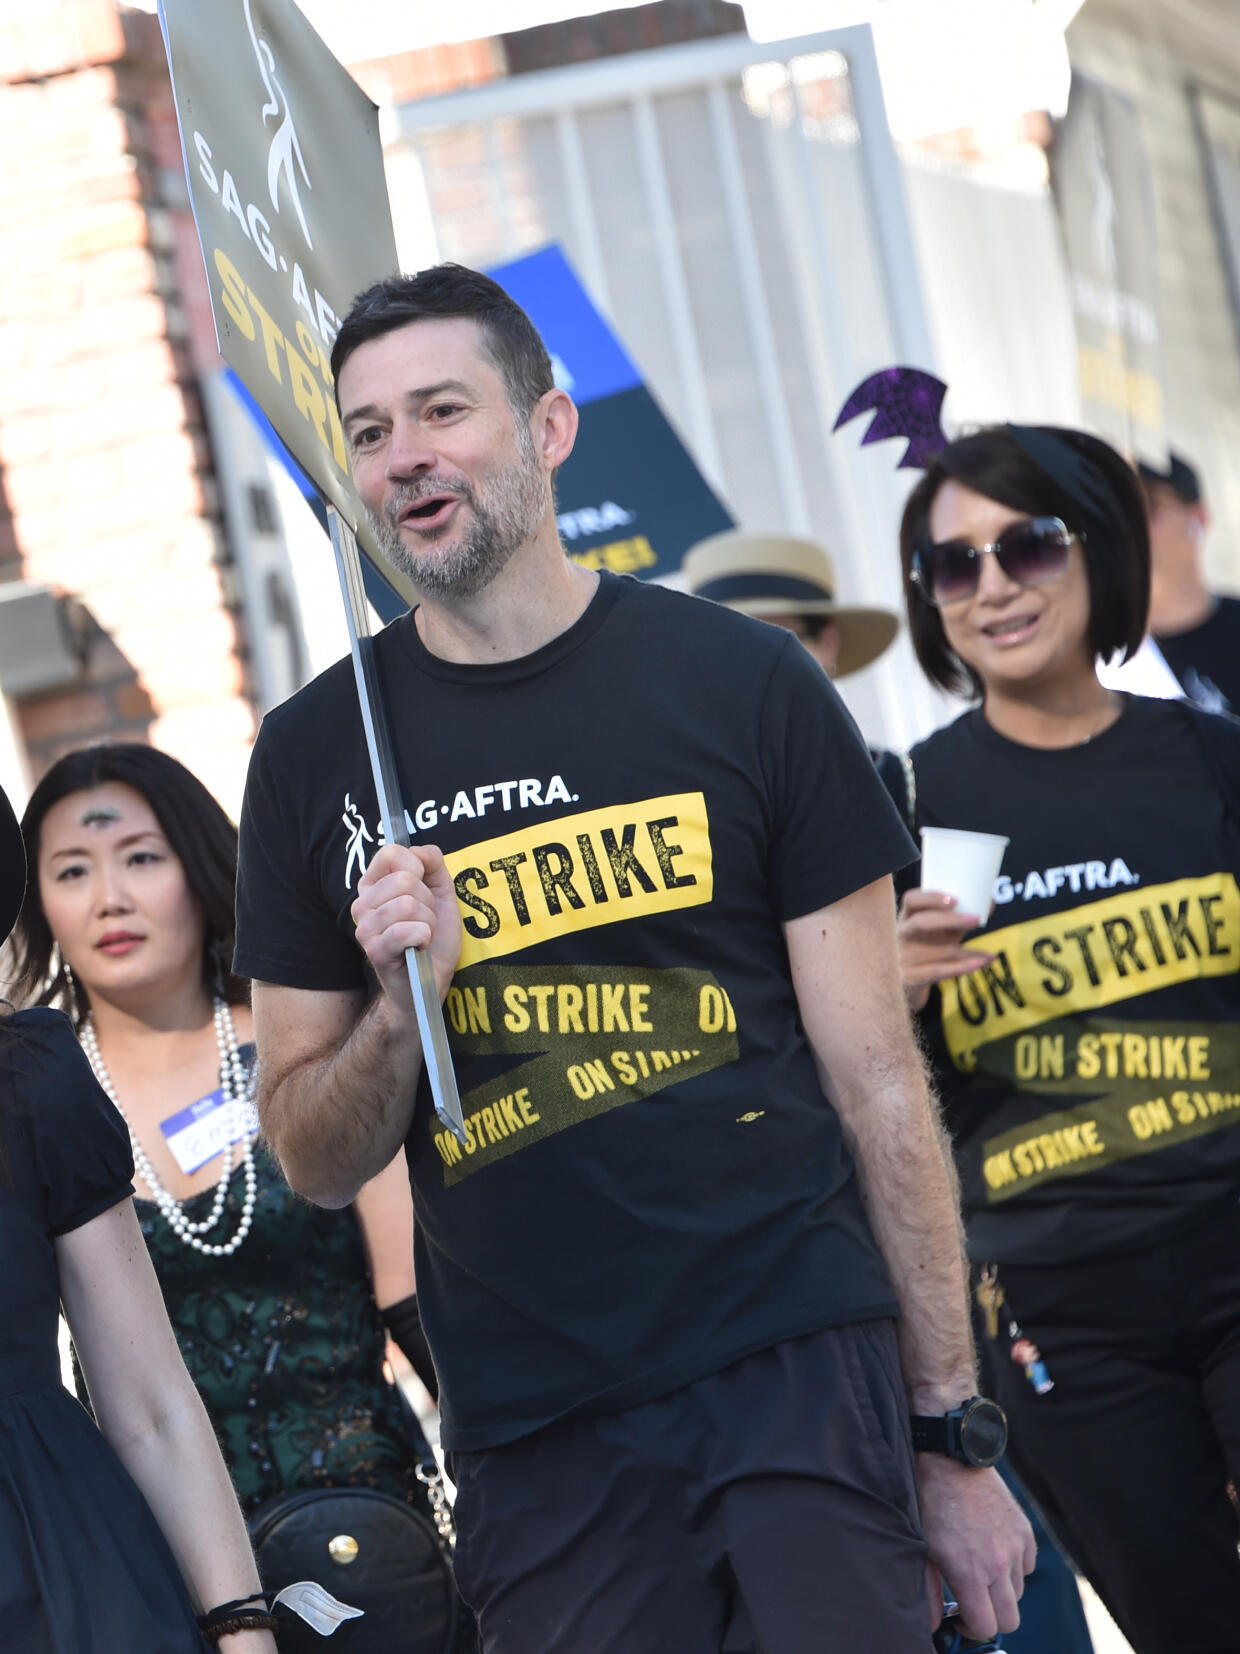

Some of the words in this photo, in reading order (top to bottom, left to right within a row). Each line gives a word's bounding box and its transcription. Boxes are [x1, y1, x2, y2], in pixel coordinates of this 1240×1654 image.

[453, 816, 697, 939] STRIKE
[1031, 894, 1231, 998] STRIKE
[446, 986, 492, 1034] ON
[503, 984, 654, 1034] STRIKE
[1015, 1035, 1064, 1080] ON
[1076, 1033, 1211, 1081] STRIKE
[434, 1130, 463, 1167] ON
[463, 1087, 540, 1155] STRIKE
[566, 1058, 616, 1101] ON
[984, 1149, 1018, 1190] ON
[1013, 1120, 1105, 1178] STRIKE
[1128, 1097, 1173, 1140] ON
